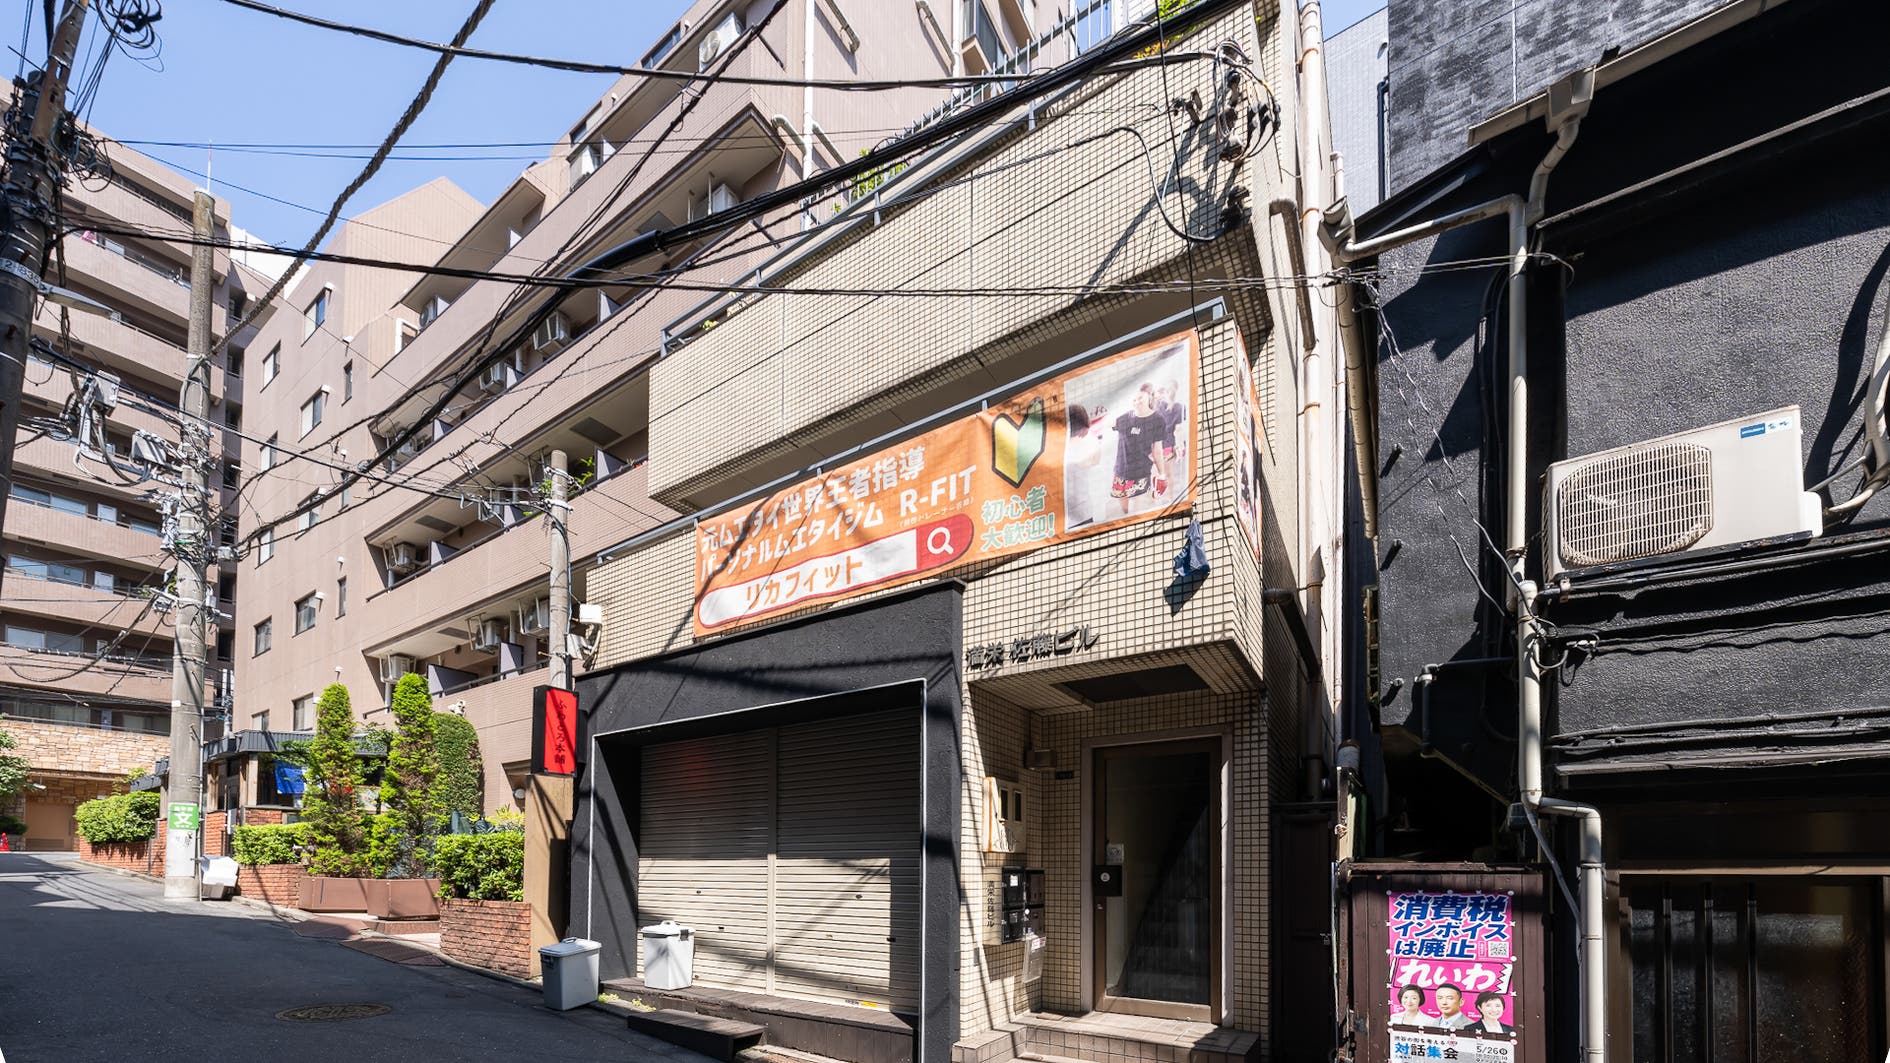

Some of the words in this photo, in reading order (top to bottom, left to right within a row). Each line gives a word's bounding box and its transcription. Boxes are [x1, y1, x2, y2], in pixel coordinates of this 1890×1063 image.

[700, 446, 926, 555] 元ムエタイ世界王者指導
[900, 465, 977, 517] R-FIT
[981, 485, 1046, 526] 初心者
[745, 555, 864, 610] リカフィット
[173, 812, 193, 825] 文
[1393, 894, 1508, 923] 消費税
[1393, 922, 1509, 940] インボイス
[1394, 939, 1475, 960] は廃止
[1396, 958, 1497, 991] れいわ
[1395, 1042, 1460, 1060] 対話集会
